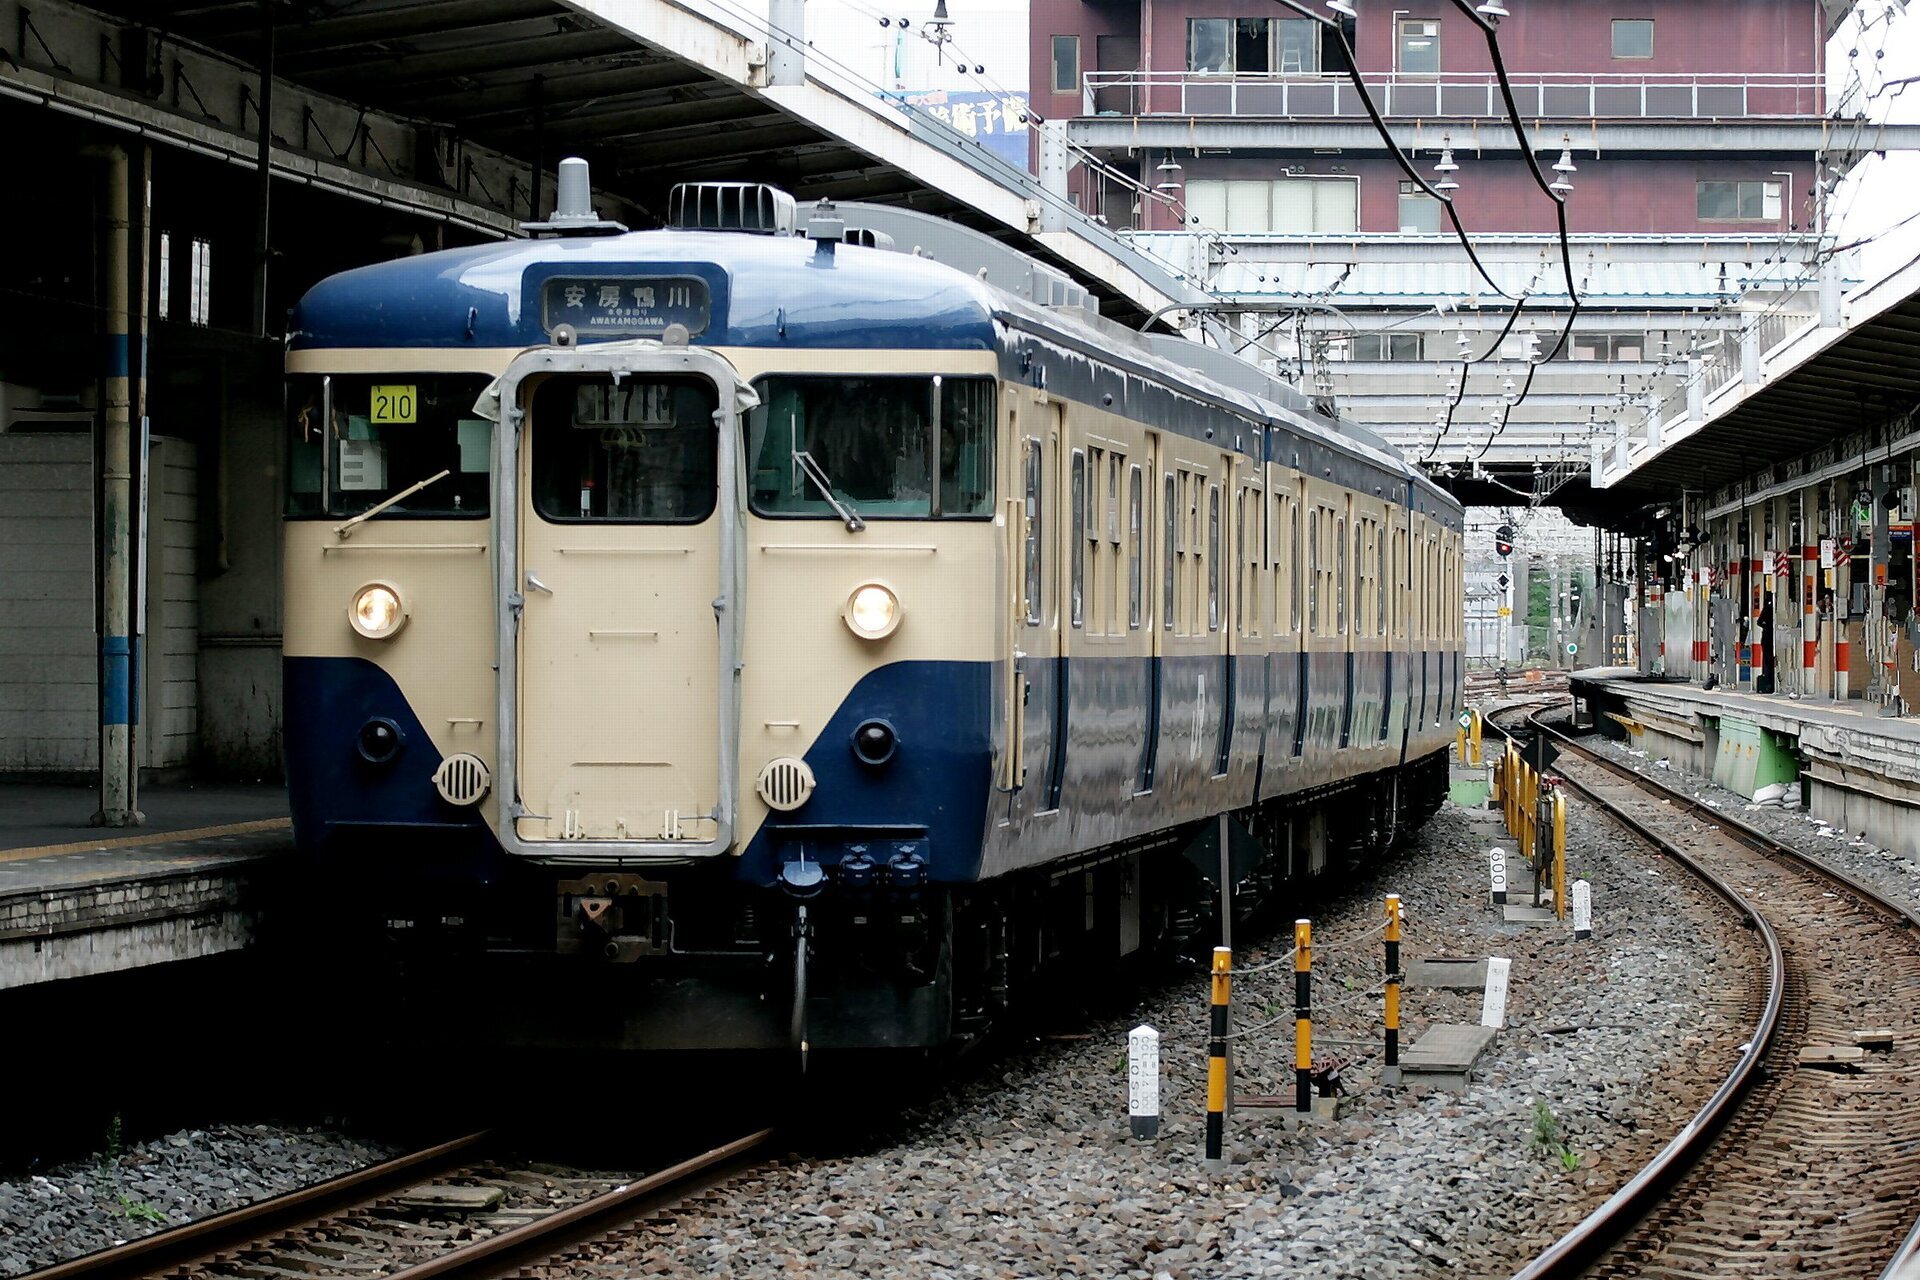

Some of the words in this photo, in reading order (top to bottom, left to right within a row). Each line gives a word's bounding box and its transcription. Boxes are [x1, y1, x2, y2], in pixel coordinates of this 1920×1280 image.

[564, 284, 691, 309] 安房鴨川
[590, 316, 664, 326] AWAKAMOGAWA
[376, 395, 411, 419] 210
[1491, 852, 1505, 885] 800
